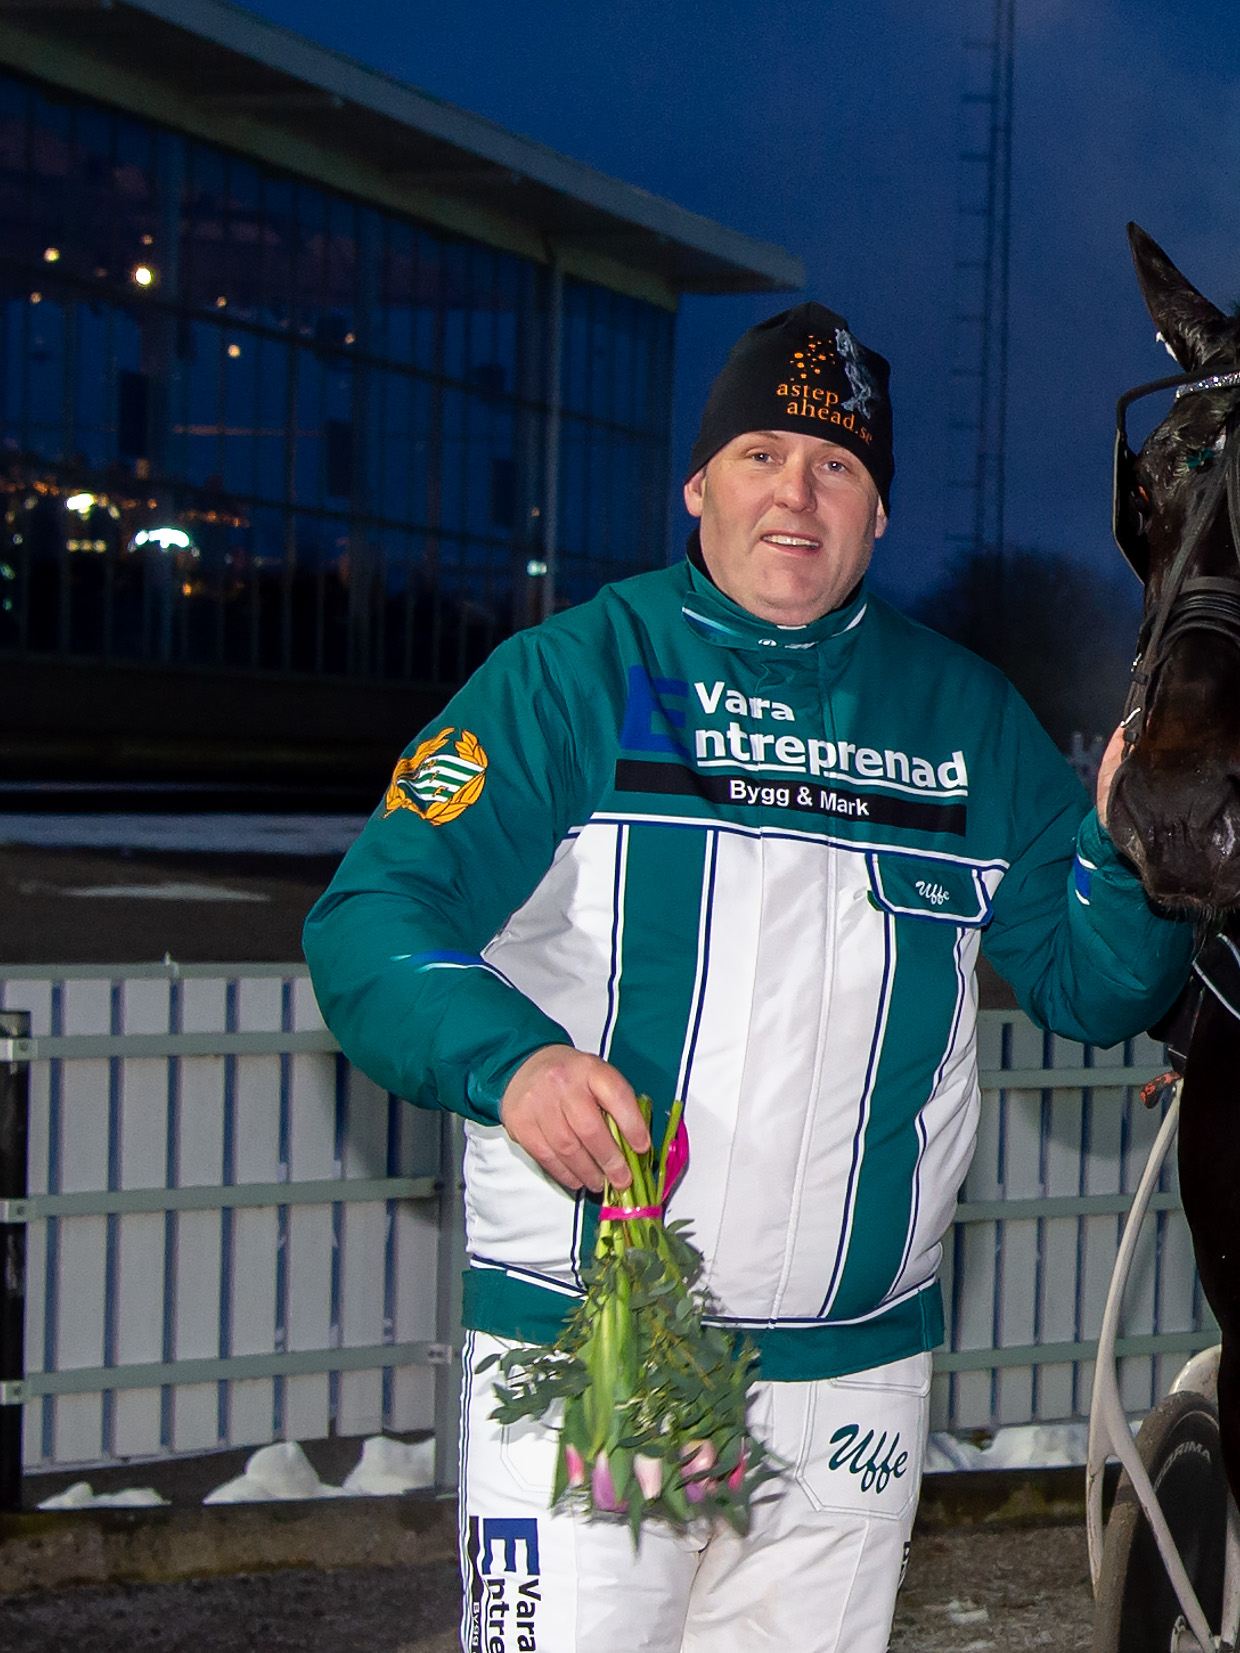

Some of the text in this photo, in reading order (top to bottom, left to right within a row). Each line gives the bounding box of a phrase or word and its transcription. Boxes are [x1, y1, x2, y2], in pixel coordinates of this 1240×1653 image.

[776, 382, 840, 406] astep
[693, 681, 796, 722] Vara
[729, 780, 870, 816] Bygg & Mark
[914, 880, 950, 905] Uffe
[828, 1423, 909, 1494] Uffe
[516, 1578, 541, 1652] Vara
